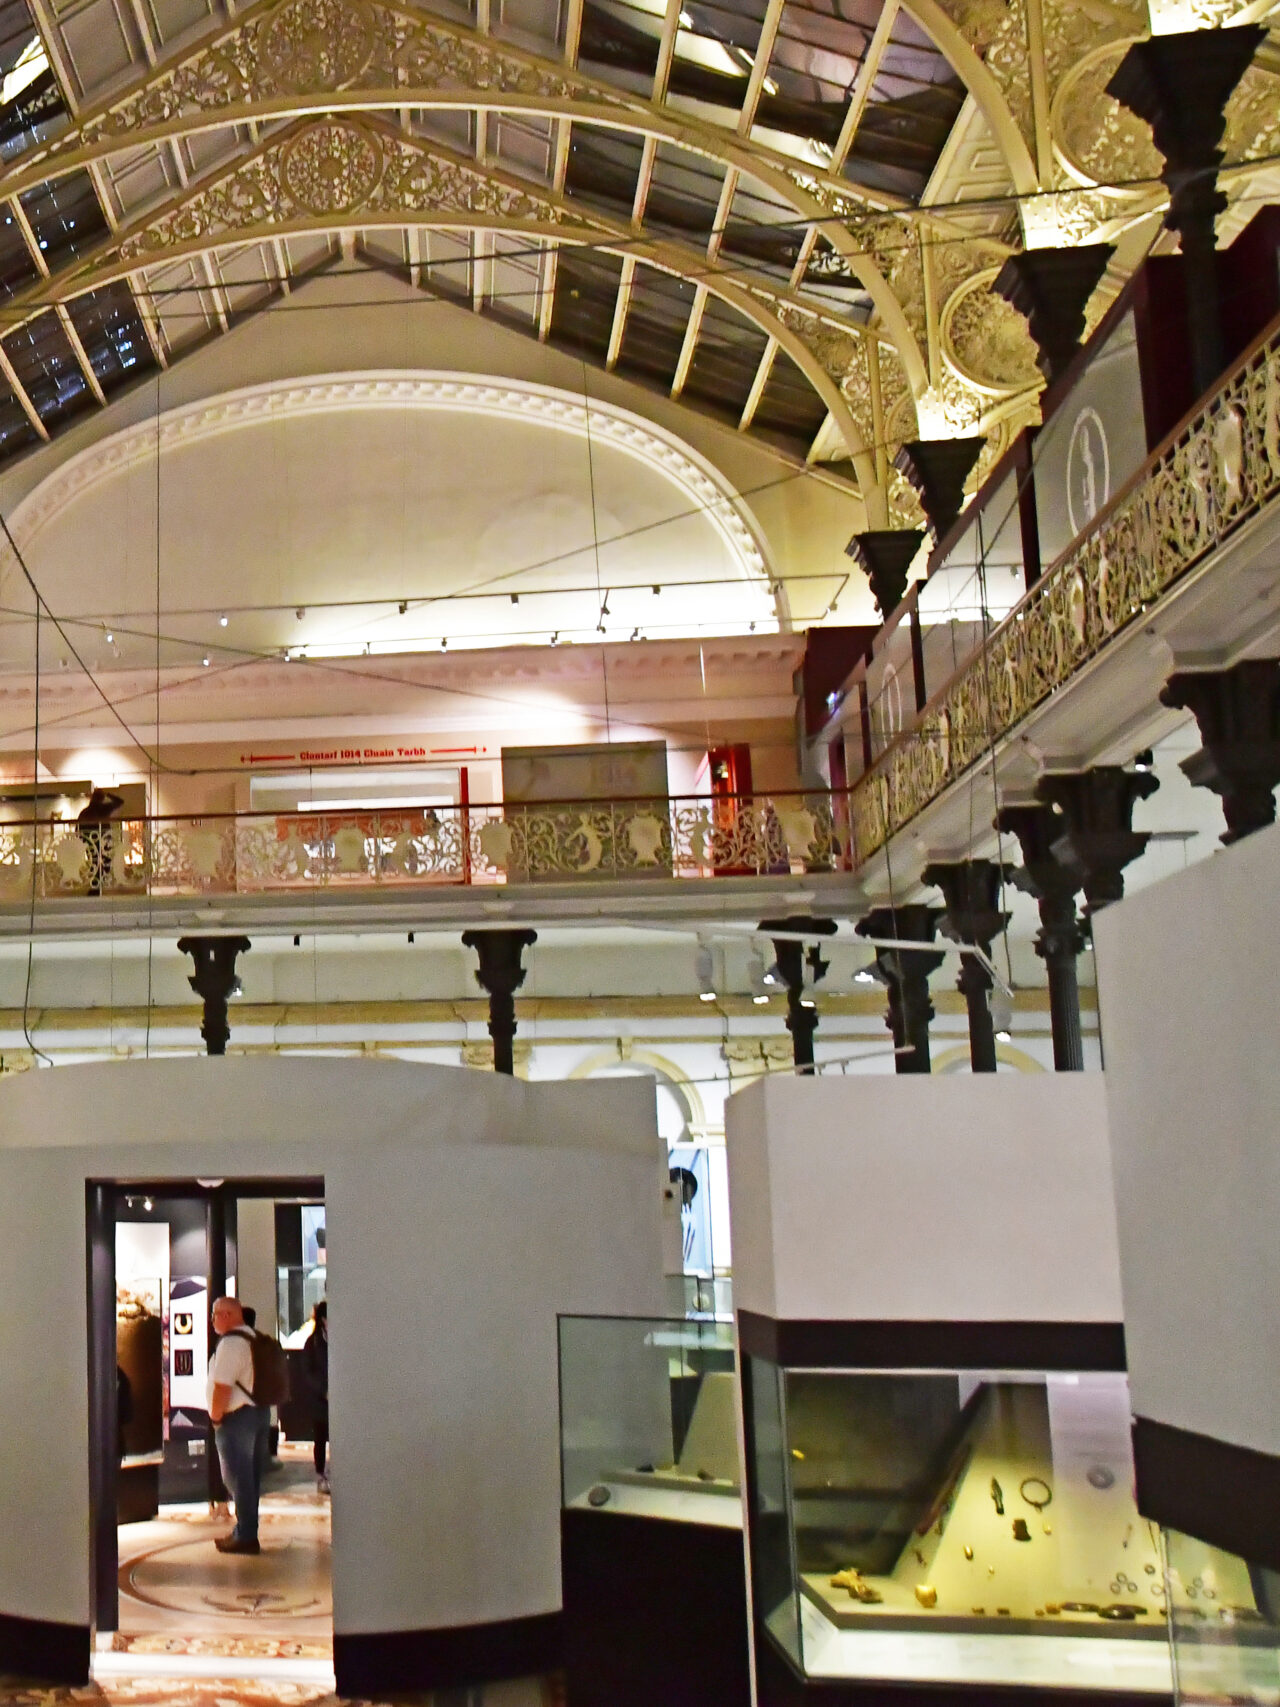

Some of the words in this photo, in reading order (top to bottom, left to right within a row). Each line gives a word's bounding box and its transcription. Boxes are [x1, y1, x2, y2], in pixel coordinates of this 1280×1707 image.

[300, 751, 337, 760] Clontarf
[340, 749, 361, 759] 1014
[364, 749, 394, 758] Cluain
[397, 748, 426, 756] Tarbh
